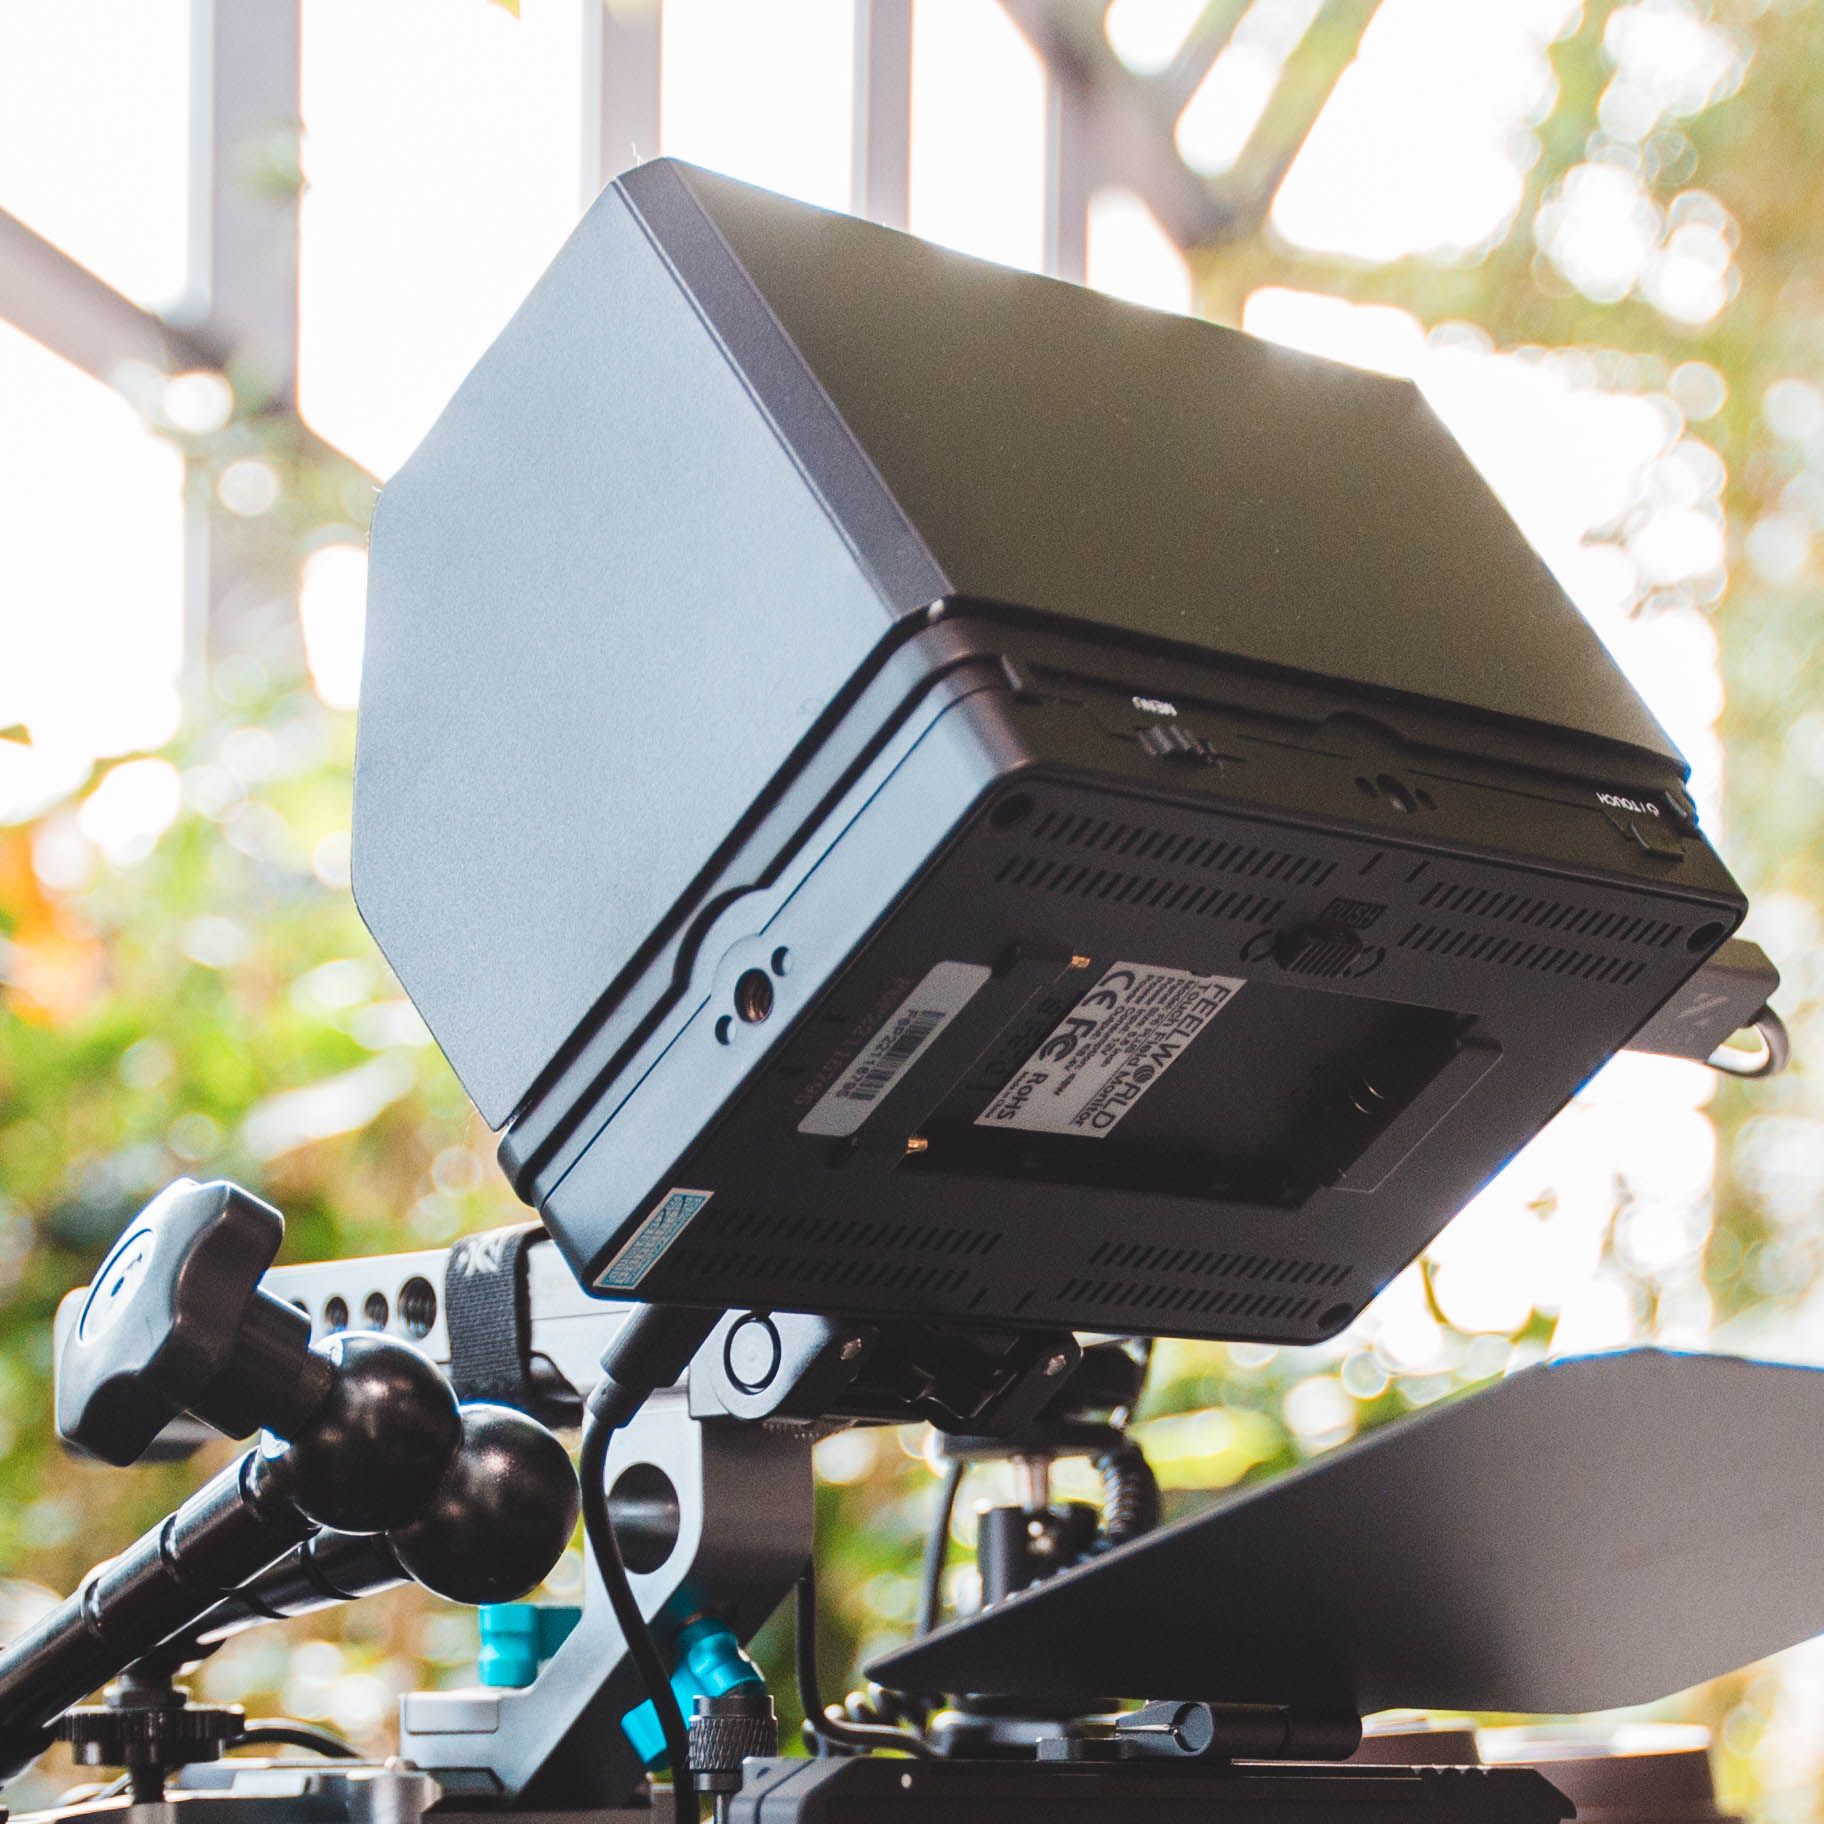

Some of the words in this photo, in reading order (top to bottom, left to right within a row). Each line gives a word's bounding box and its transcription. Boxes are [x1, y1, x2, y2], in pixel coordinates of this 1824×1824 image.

[1326, 897, 1385, 928] PUSH
[1163, 984, 1209, 1026] Touch
[1092, 985, 1229, 1128] FEELWORLD
[1127, 1032, 1166, 1066] Field
[997, 1073, 1048, 1119] RoHS
[1074, 1071, 1129, 1126] Monitor
